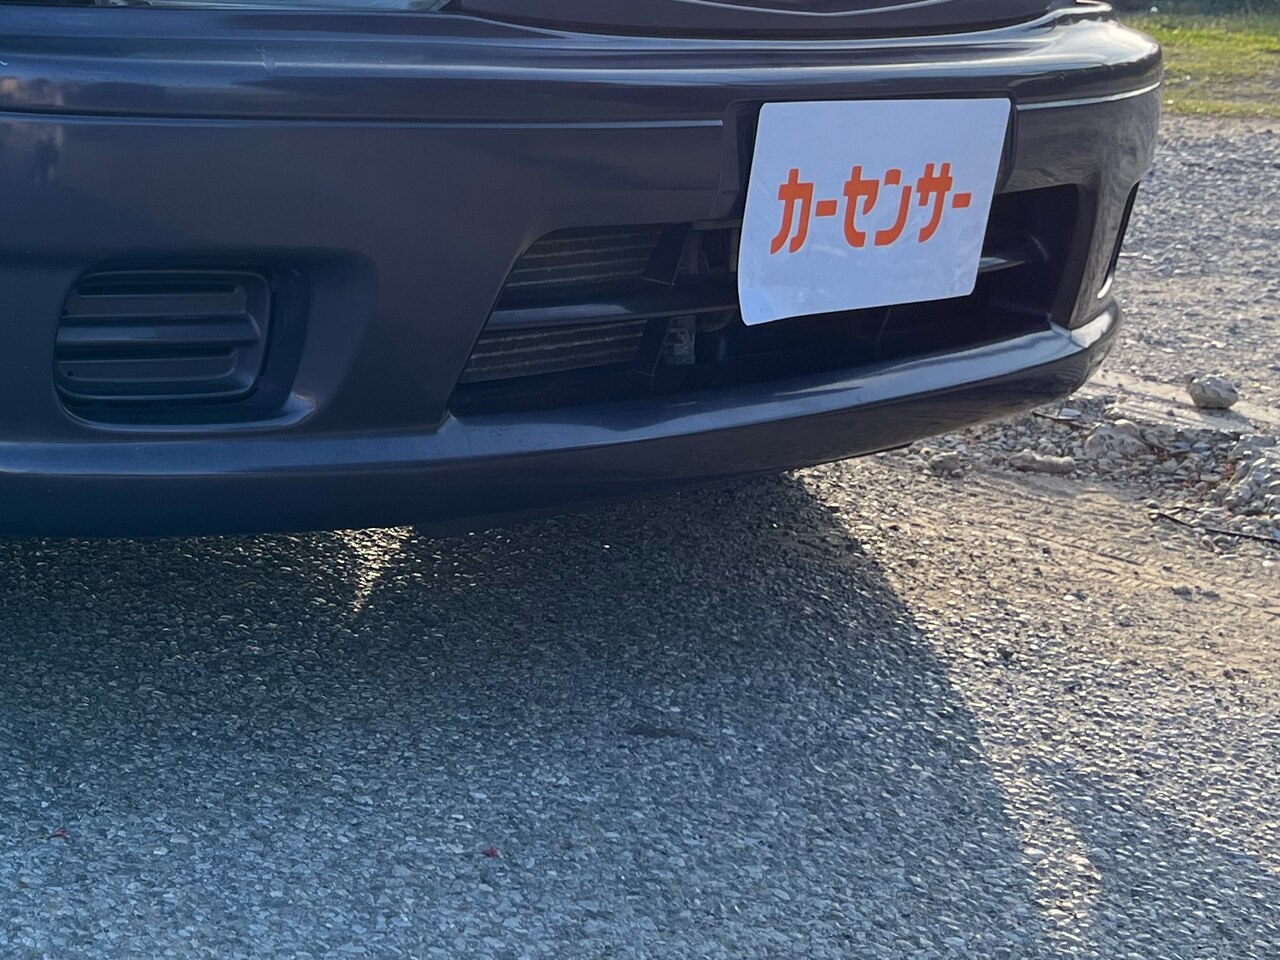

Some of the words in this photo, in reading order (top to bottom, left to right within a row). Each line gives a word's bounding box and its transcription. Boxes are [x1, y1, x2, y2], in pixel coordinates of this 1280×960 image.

[770, 162, 972, 254] カーセンサー
